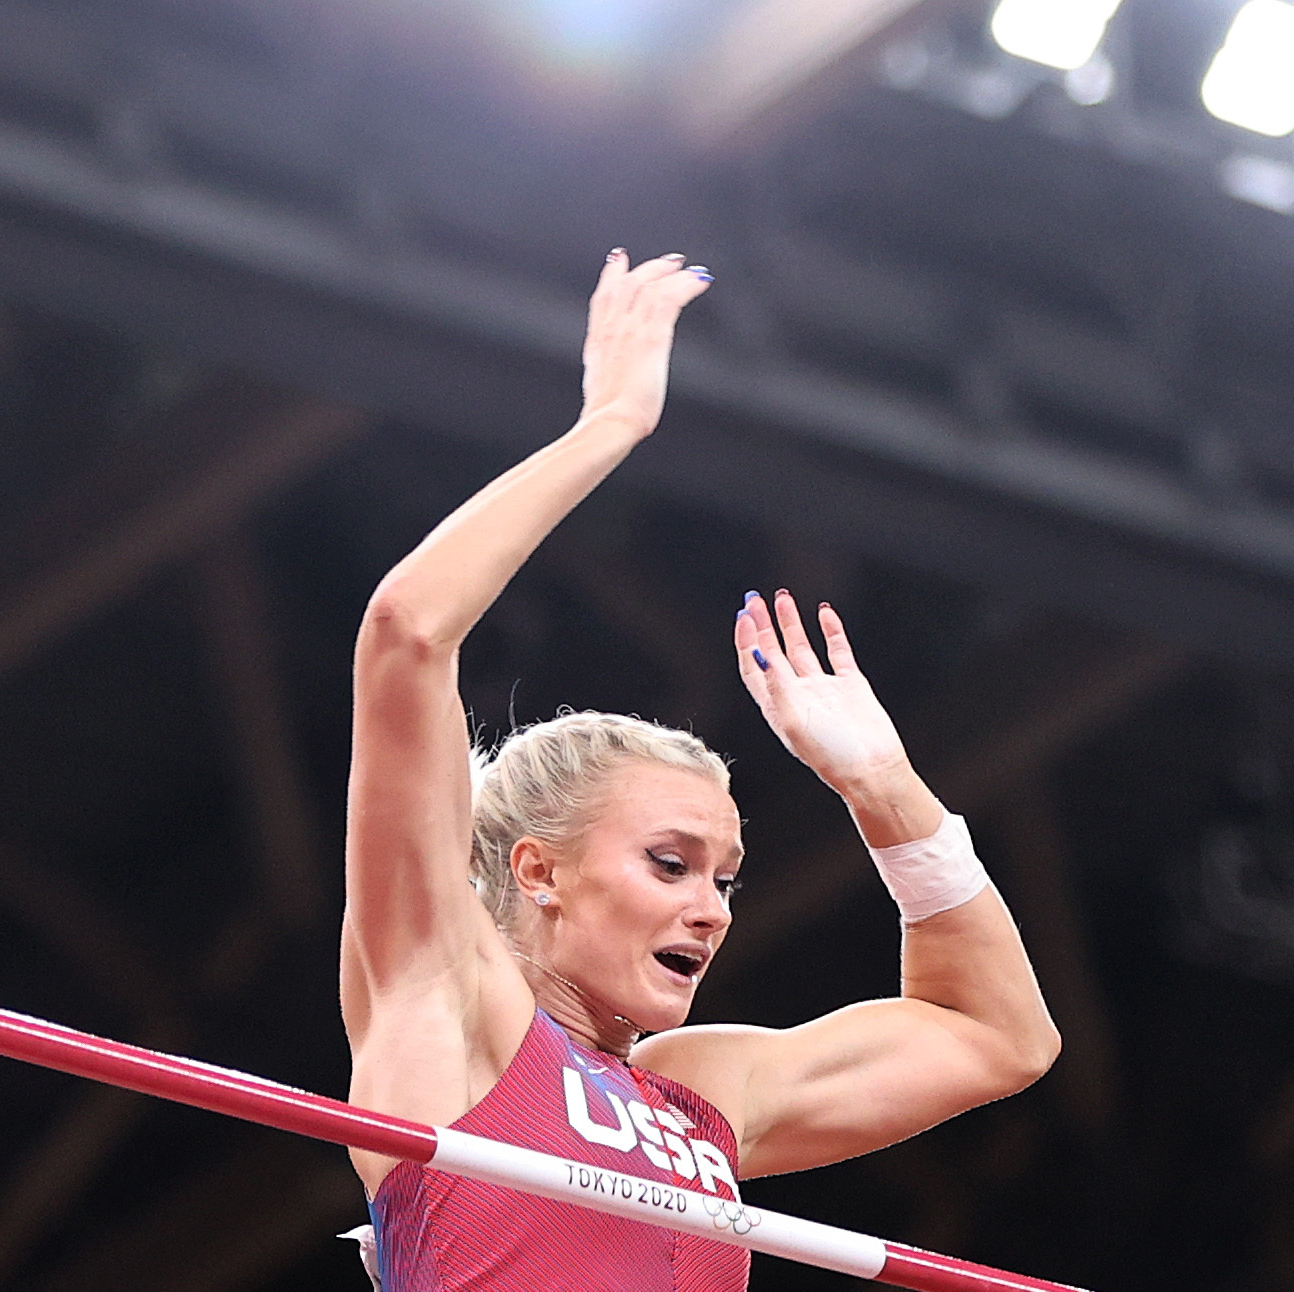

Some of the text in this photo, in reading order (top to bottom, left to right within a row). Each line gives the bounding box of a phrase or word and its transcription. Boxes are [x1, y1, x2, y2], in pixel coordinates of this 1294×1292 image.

[563, 1067, 741, 1203] USA
[566, 1165, 687, 1213] TOKYO 2020
